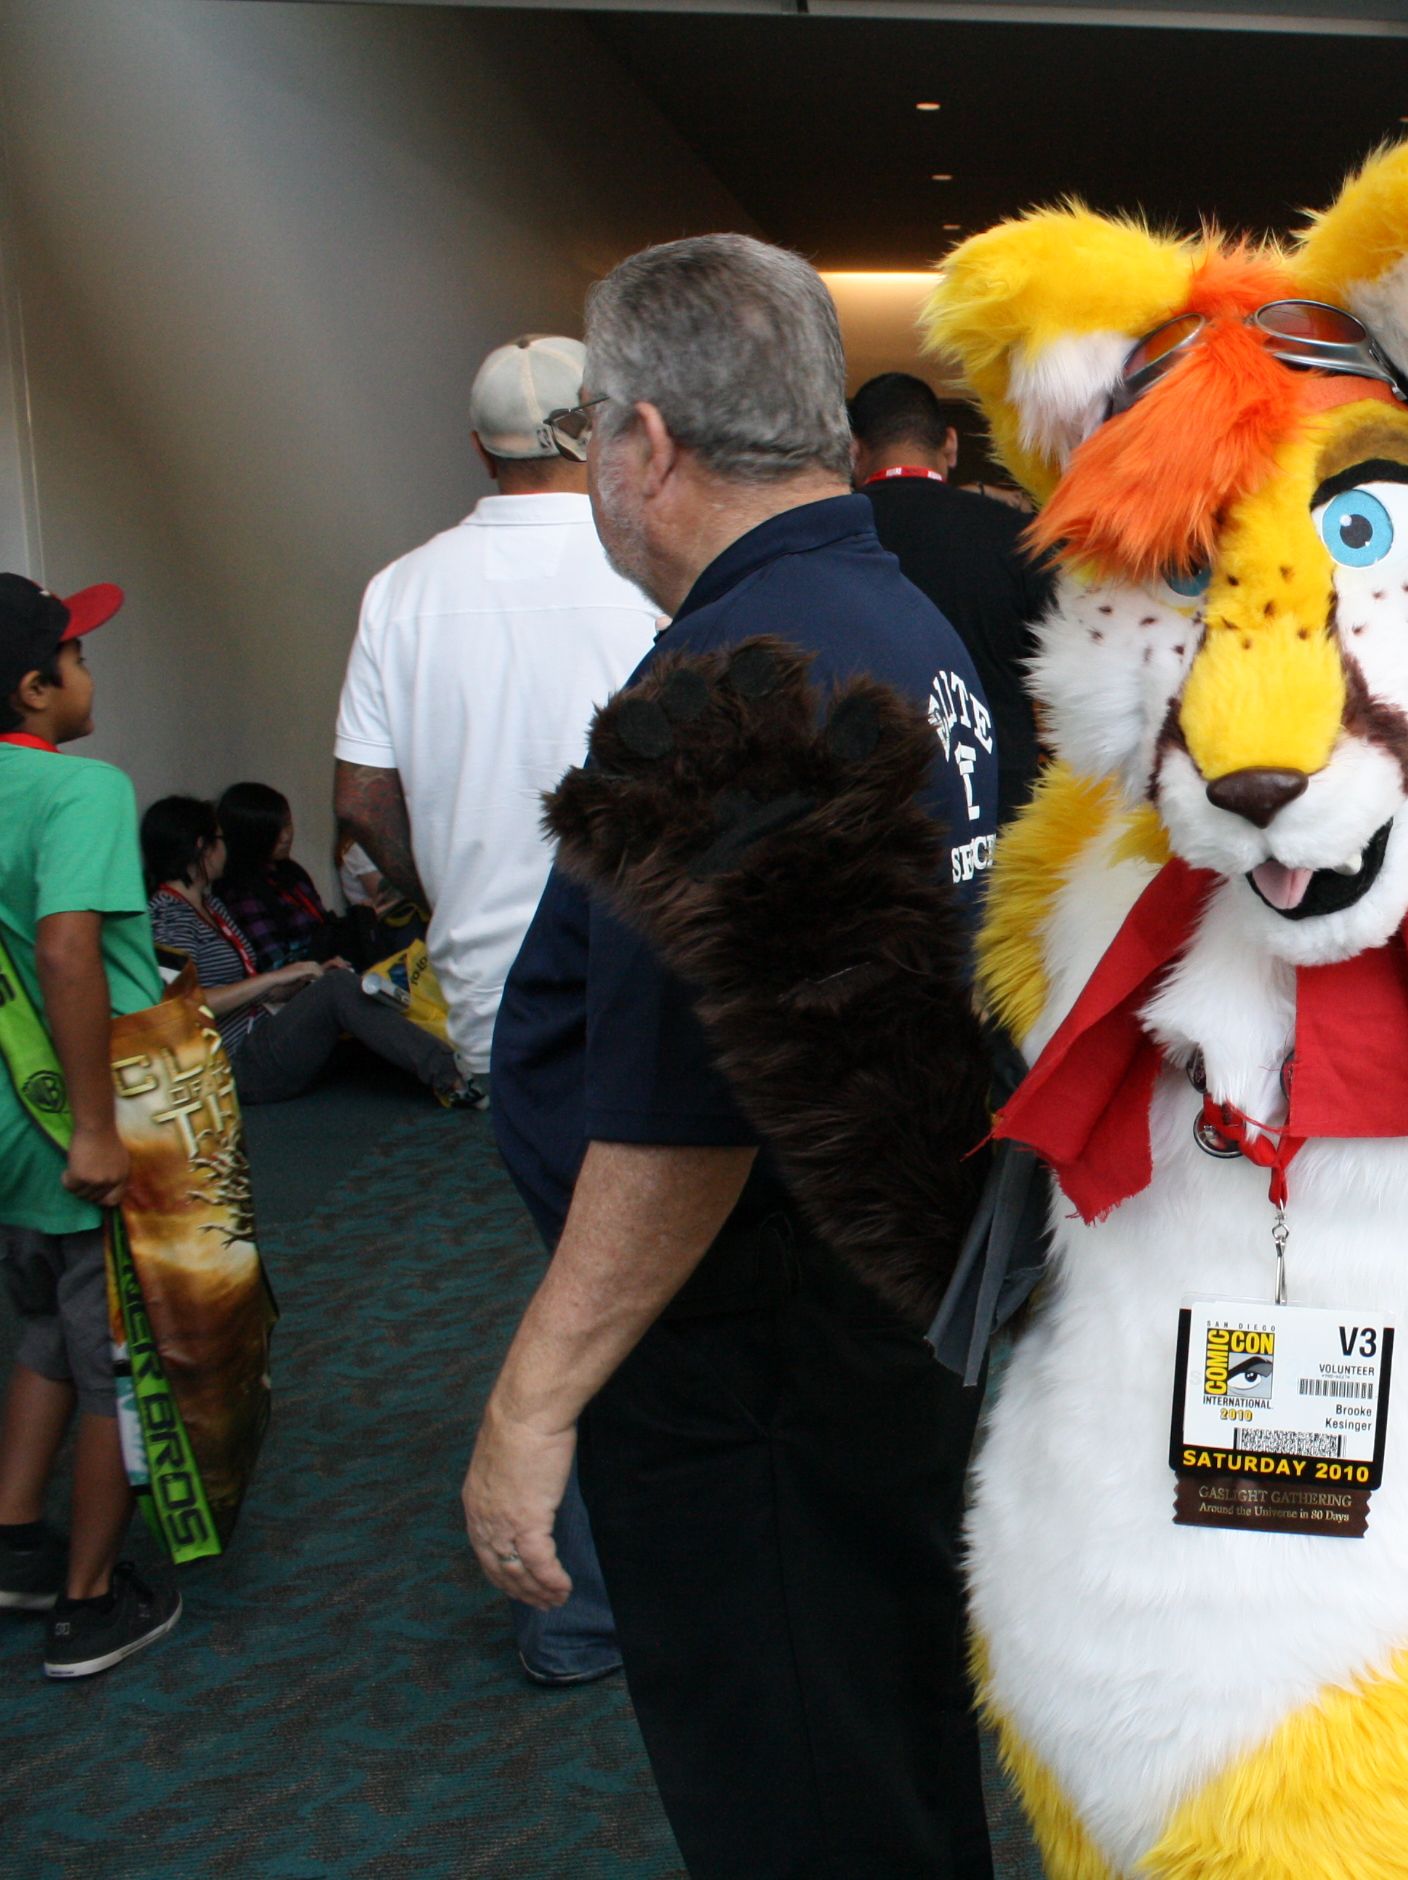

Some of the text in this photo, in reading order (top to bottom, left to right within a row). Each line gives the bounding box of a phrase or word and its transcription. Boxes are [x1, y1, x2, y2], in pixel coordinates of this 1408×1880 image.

[1207, 1320, 1276, 1331] SAN DIEGO
[1230, 1331, 1274, 1354] CON
[1338, 1326, 1377, 1357] V3
[1205, 1329, 1230, 1395] COMIC
[1319, 1364, 1375, 1376] VOLUNTEER
[1202, 1395, 1272, 1409] INTERNATIONAL
[1335, 1404, 1373, 1417] Brooke
[1220, 1407, 1253, 1422] 2010
[1325, 1418, 1372, 1431] Kesinger
[1182, 1450, 1369, 1482] SATURDAY 2010
[1198, 1485, 1352, 1507] GASLIGHT GATHERING
[1199, 1502, 1350, 1523] Around the Universe in 80 Days
